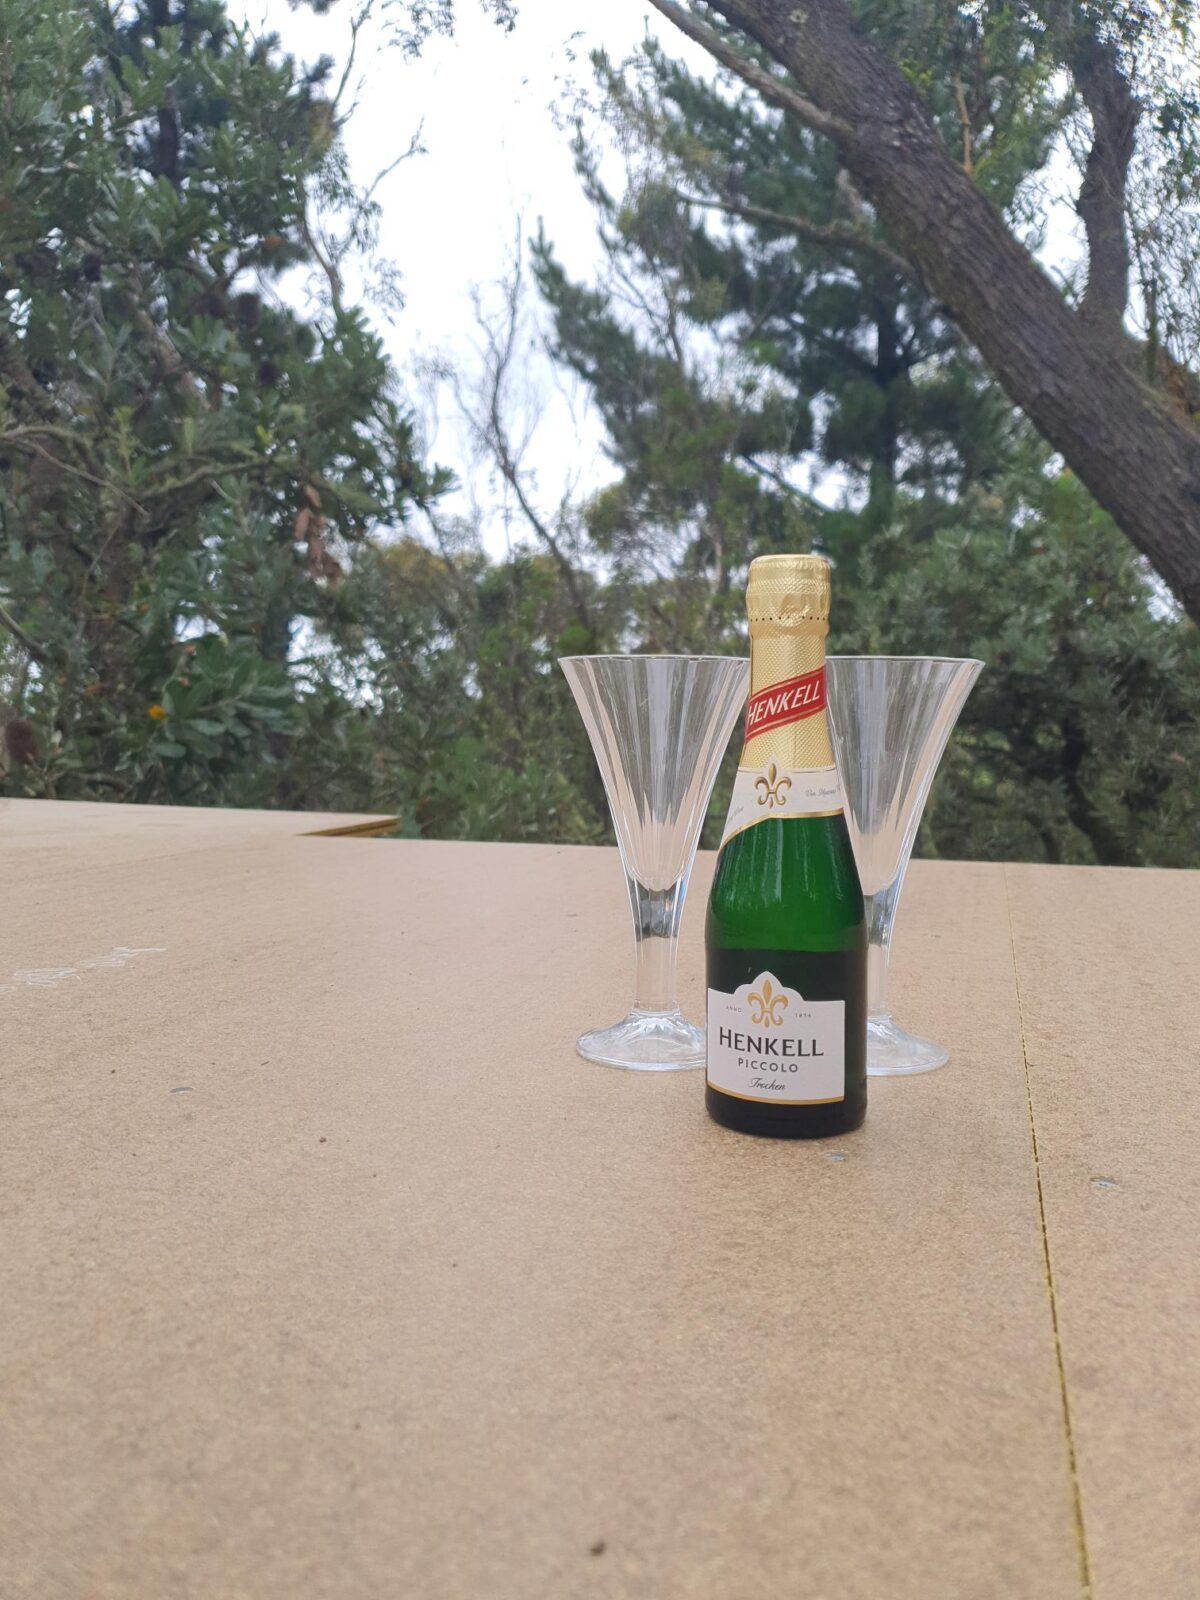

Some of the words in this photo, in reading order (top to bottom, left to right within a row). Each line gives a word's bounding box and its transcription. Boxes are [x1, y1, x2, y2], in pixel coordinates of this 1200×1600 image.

[747, 680, 820, 726] HENKELL
[719, 1026, 824, 1057] HENKELL
[738, 1057, 798, 1073] PICCOLO
[749, 1077, 785, 1091] Trocken
